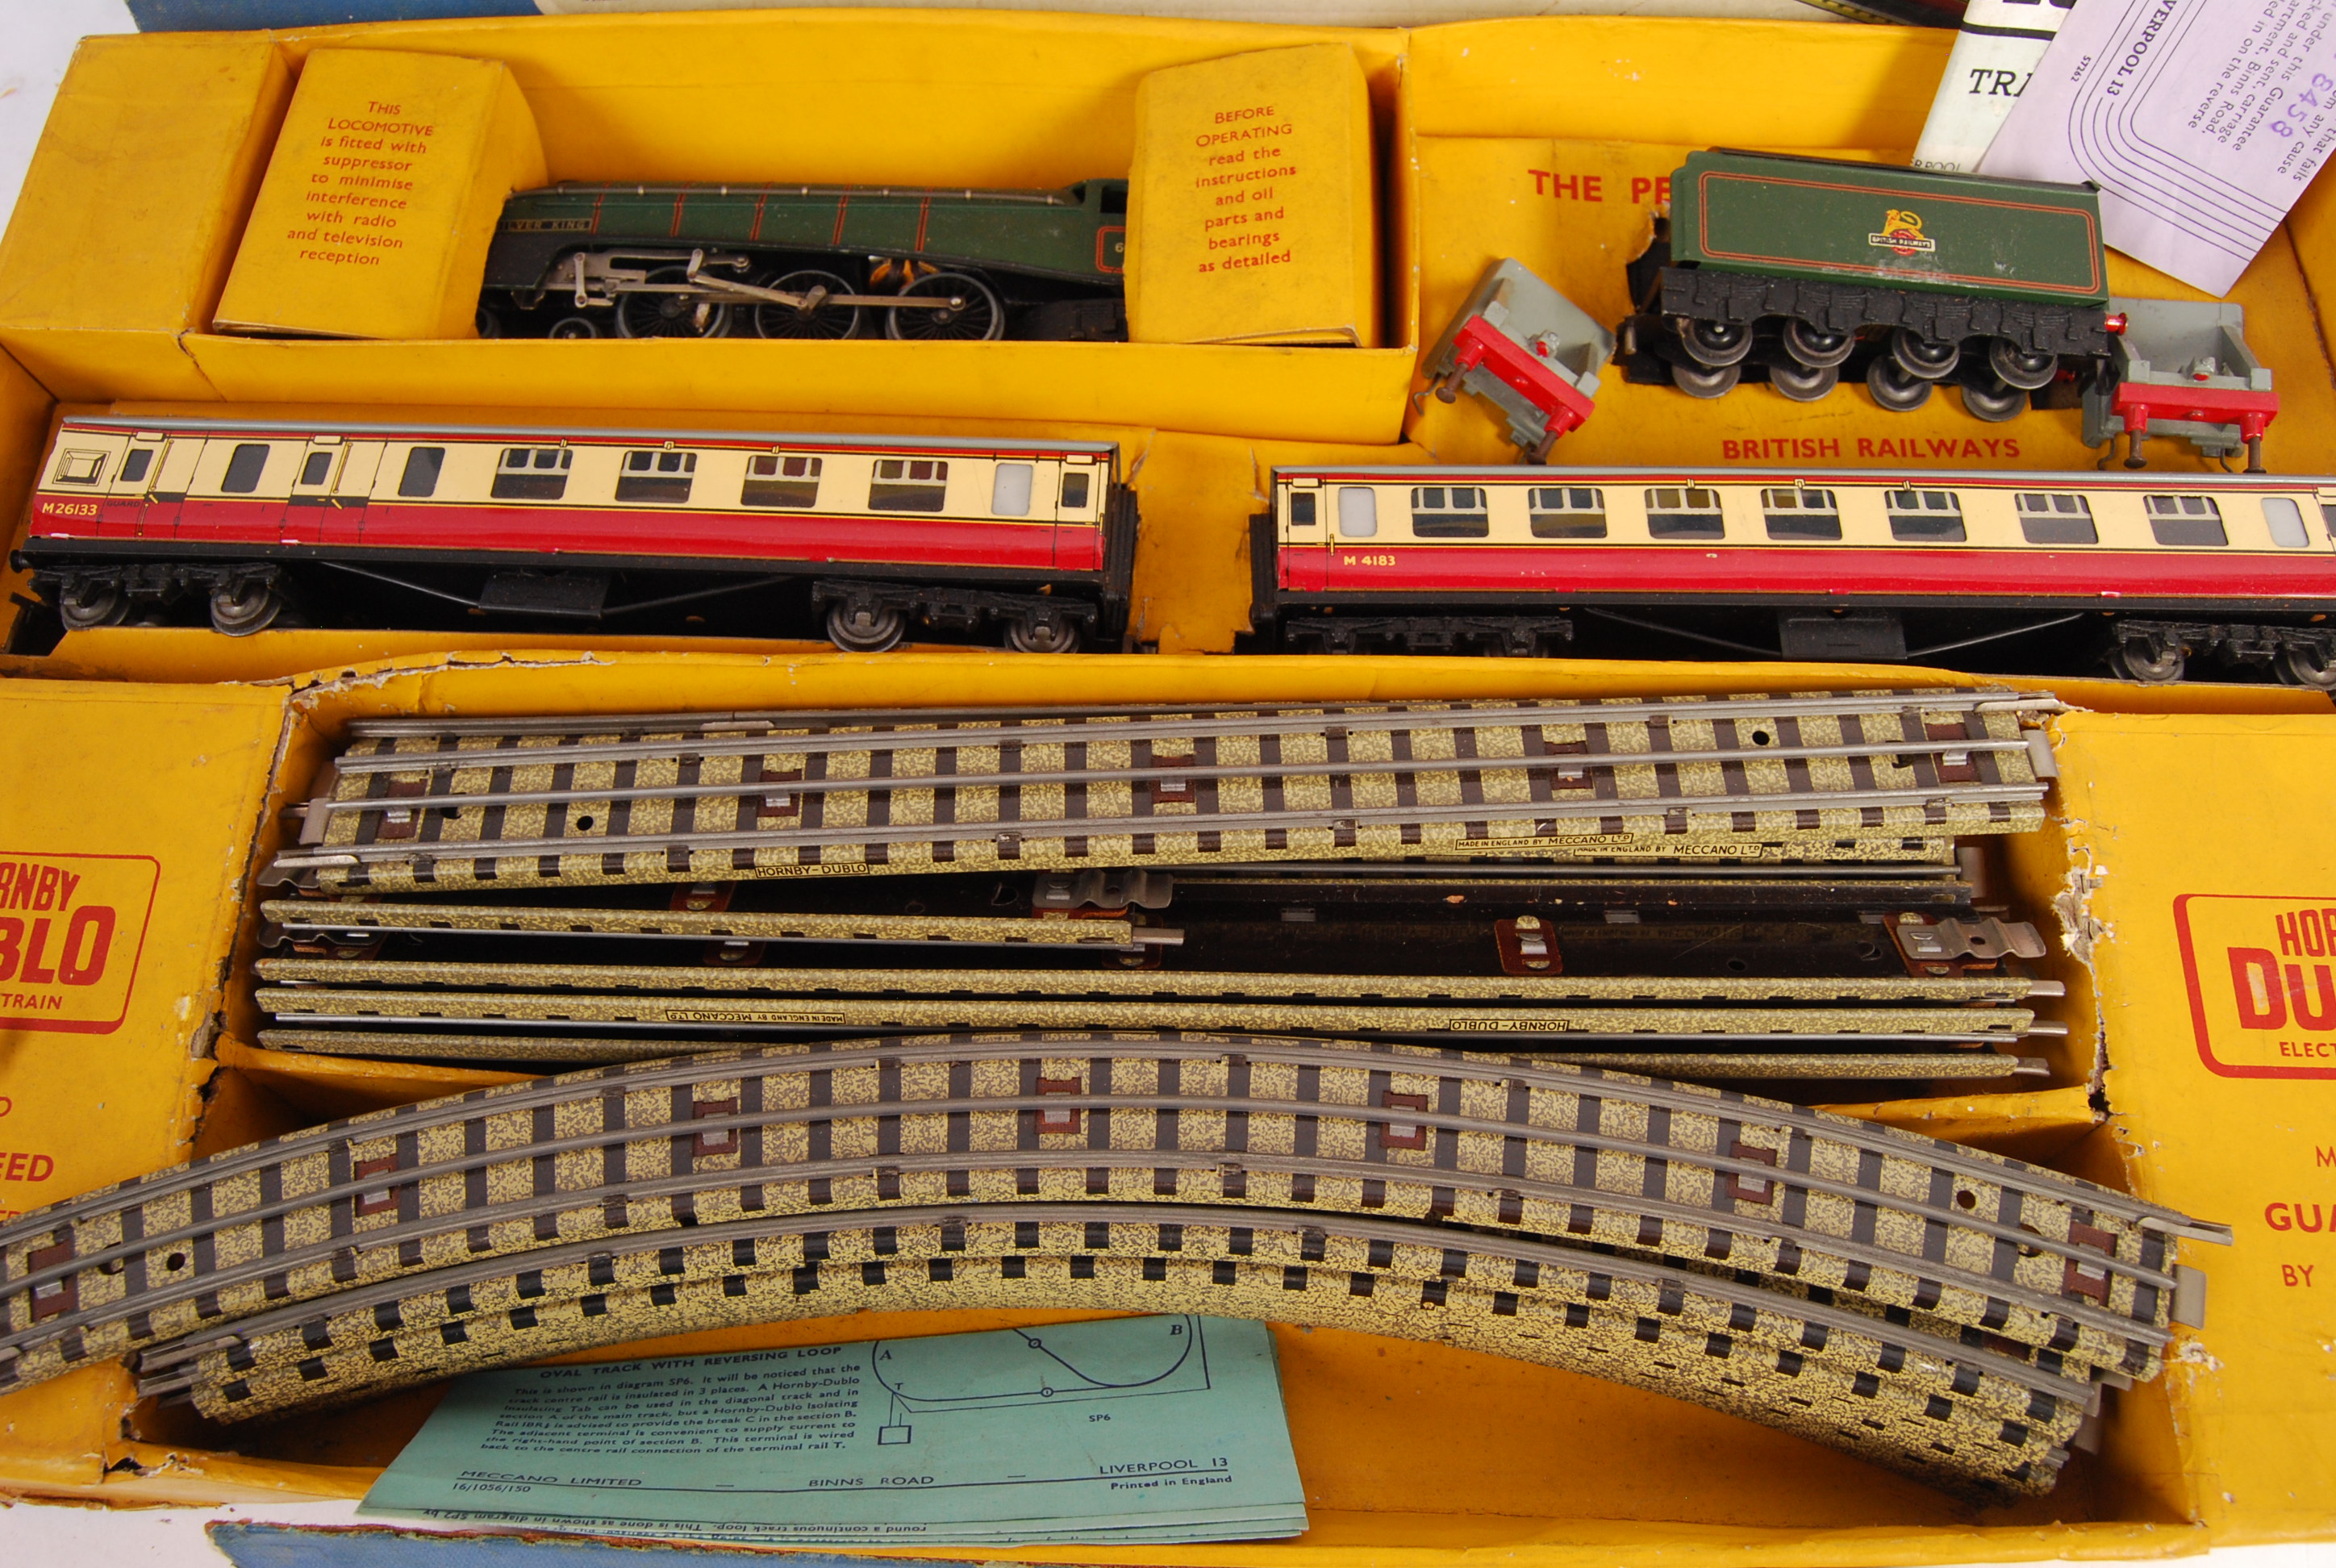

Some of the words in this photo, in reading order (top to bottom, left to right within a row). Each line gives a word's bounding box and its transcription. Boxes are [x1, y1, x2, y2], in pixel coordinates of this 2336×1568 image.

[2252, 21, 2265, 33] in
[2302, 13, 2332, 52] under
[2238, 38, 2253, 54] on
[2278, 32, 2297, 58] and
[2221, 57, 2242, 79] the
[2281, 56, 2303, 81] this
[2230, 61, 2261, 95] Binns
[2107, 80, 2124, 95] 13
[368, 102, 401, 115] THIS
[2188, 82, 2223, 128] reverse
[1215, 106, 1274, 123] BEFORE
[2218, 94, 2255, 143] carriage
[2233, 87, 2284, 151] Guarantee
[328, 119, 434, 136] LOCOMOTIVE
[2303, 115, 2325, 138] any
[1196, 124, 1292, 147] OPERATING
[321, 136, 332, 146] is
[339, 136, 383, 150] fitted
[390, 143, 427, 153] with
[323, 156, 412, 171] suppressor
[1209, 150, 1245, 165] read
[1254, 147, 1281, 159] the
[2278, 141, 2305, 173] cause
[1196, 166, 1296, 187] instructions
[2293, 158, 2317, 181] fails
[311, 173, 328, 183] to
[339, 176, 413, 190] minimise
[1528, 169, 1603, 202] THE
[306, 191, 407, 209] interference
[1216, 190, 1245, 206] and
[1252, 187, 1273, 200] oil
[307, 211, 343, 223] with
[353, 215, 396, 227] radio
[552, 219, 586, 231] KING
[1205, 215, 1247, 231] parts
[1255, 206, 1284, 222] and
[287, 229, 318, 240] and
[323, 231, 403, 248] television
[1209, 232, 1279, 249] bearings
[300, 250, 380, 265] reception
[1199, 262, 1215, 272] as
[1223, 250, 1291, 269] detailed
[1723, 438, 1841, 460] BRITISH
[1858, 438, 2020, 458] RAILWAYS
[1344, 556, 1355, 565] M
[1362, 556, 1395, 565] 4183
[1548, 836, 1606, 844] MECCANO
[1673, 845, 1737, 854] MECCANO
[0, 905, 116, 986] BLO
[2227, 947, 2336, 1031] DU
[1, 994, 62, 1010] TRAIN
[693, 1012, 752, 1020] MECCANO
[2265, 1203, 2336, 1232] GU
[2281, 1264, 2313, 1287] BY
[1170, 1324, 1183, 1336] B
[540, 1369, 582, 1378] OVAL
[592, 1363, 641, 1374] TRACK
[652, 1359, 695, 1370] WITH
[704, 1351, 788, 1366] REVERSING
[798, 1347, 841, 1357] LOOP
[879, 1349, 892, 1361] A
[557, 1385, 594, 1394] shown
[717, 1373, 738, 1382] will
[745, 1373, 758, 1381] be
[763, 1369, 807, 1378] noticed
[812, 1367, 835, 1375] that
[841, 1364, 860, 1372] the
[625, 1390, 678, 1399] insulated
[711, 1387, 749, 1395] places.
[773, 1377, 860, 1390] Hornby-Dublo
[714, 1404, 803, 1414] Hornby-Dublo
[807, 1400, 858, 1409] Isolating
[725, 1394, 774, 1404] diagonal
[632, 1420, 679, 1428] provide
[1089, 1414, 1111, 1422] SP6
[461, 1471, 557, 1483] MECCANO
[570, 1477, 641, 1486] LIMITED
[809, 1478, 864, 1487] BINNS
[881, 1476, 934, 1485] ROAD
[1099, 1460, 1198, 1474] LIVERPOOL
[1212, 1457, 1228, 1466] 13
[453, 1483, 531, 1492] 16/1056/150
[1111, 1480, 1158, 1490] Printed
[1183, 1475, 1232, 1485] England
[474, 1512, 528, 1523] diagram
[553, 1517, 596, 1525] shown
[794, 1524, 868, 1533] continuous
